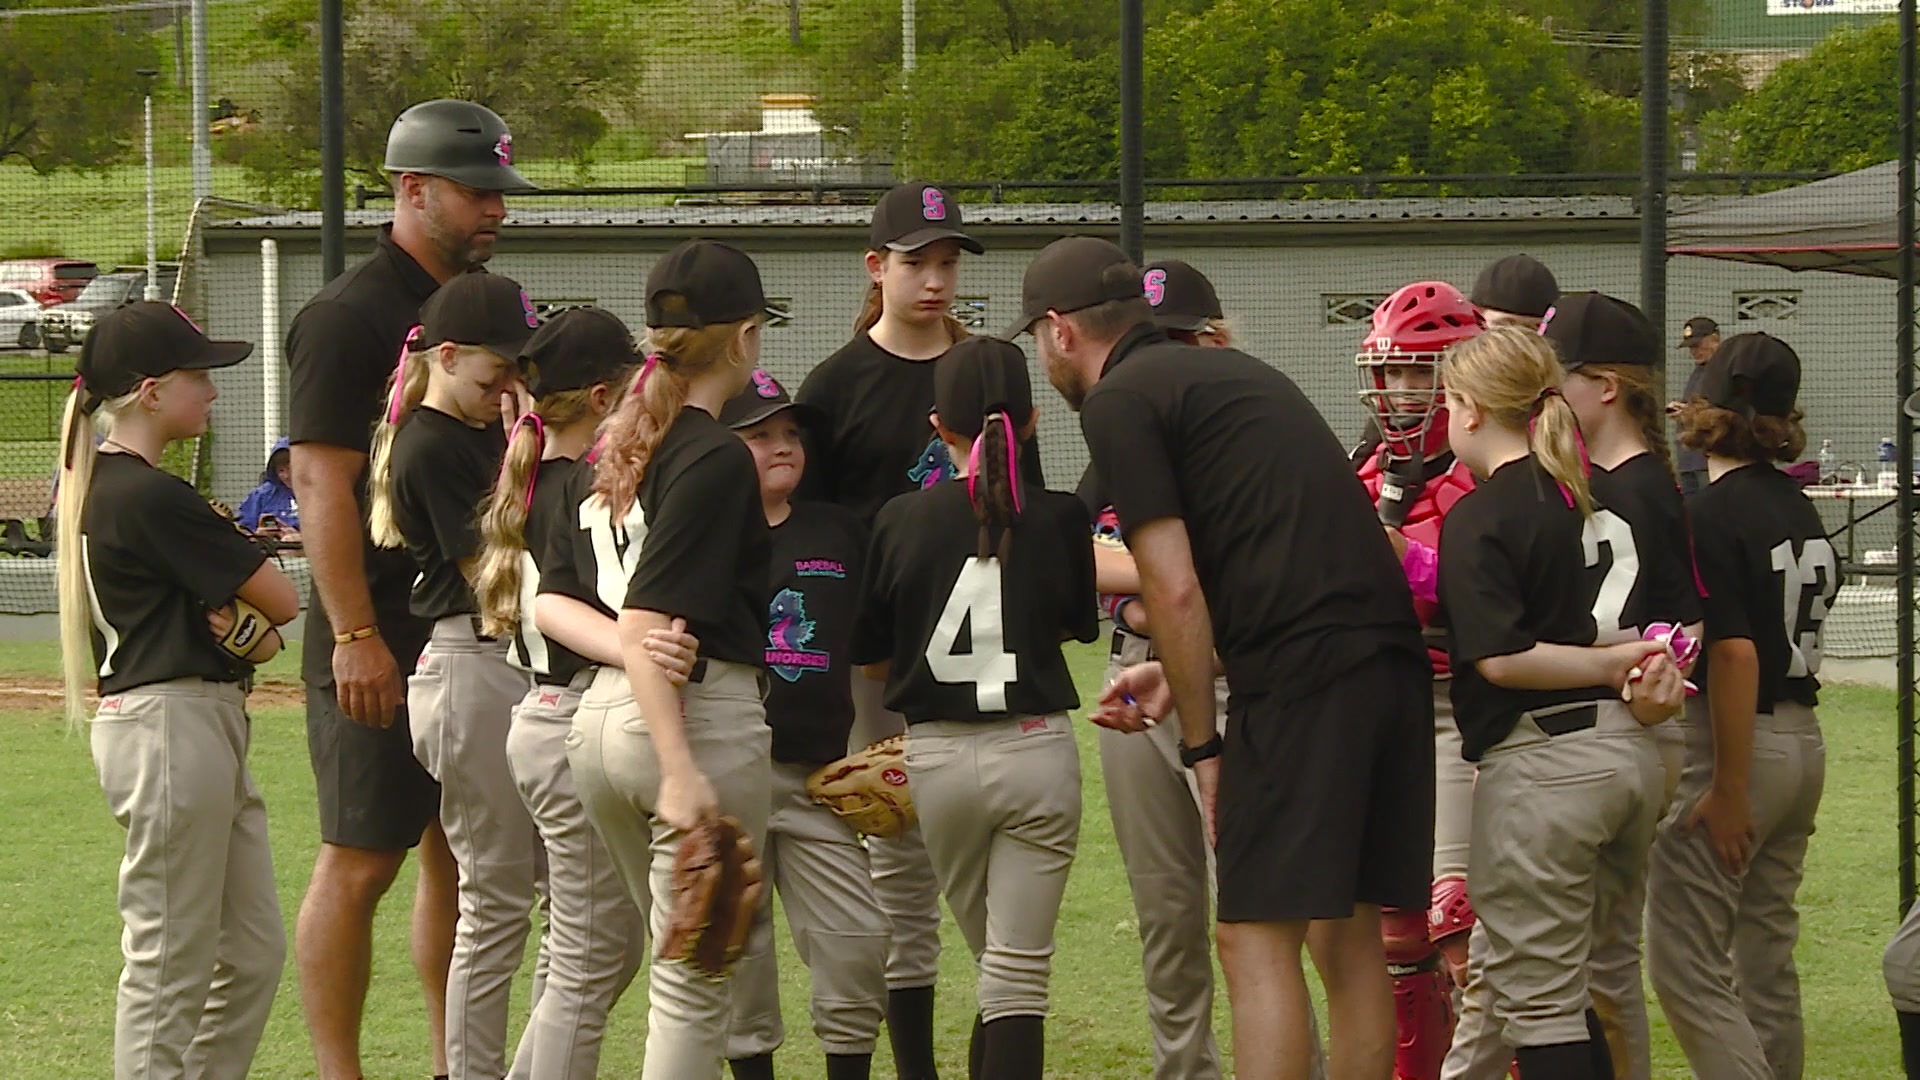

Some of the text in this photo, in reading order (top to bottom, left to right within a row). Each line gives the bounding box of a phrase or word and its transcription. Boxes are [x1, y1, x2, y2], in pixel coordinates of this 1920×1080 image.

[922, 187, 946, 220] S
[1143, 269, 1166, 306] S
[752, 368, 780, 397] S
[795, 560, 847, 572] BASEBALL
[1581, 509, 1642, 645] 2
[1770, 538, 1837, 677] 13
[925, 556, 1018, 712] 4
